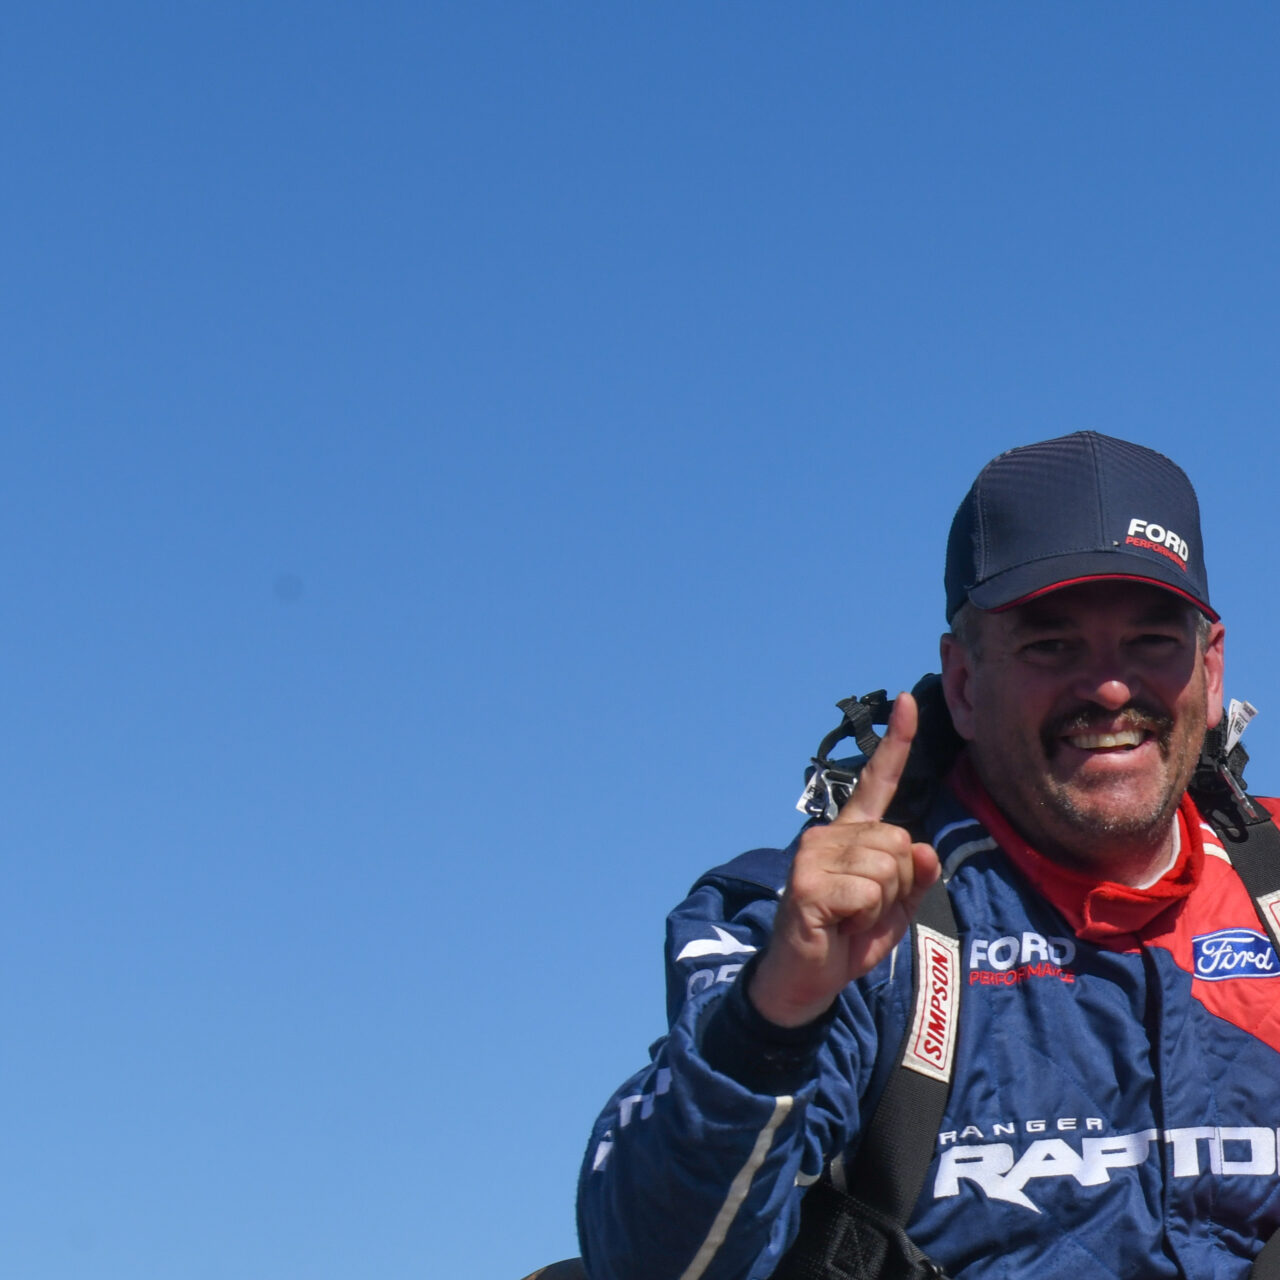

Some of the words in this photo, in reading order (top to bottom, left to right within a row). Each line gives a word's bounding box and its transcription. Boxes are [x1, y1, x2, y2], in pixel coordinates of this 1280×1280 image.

[1127, 518, 1189, 562] FORD
[969, 931, 1076, 971] FORD
[1197, 937, 1274, 972] Ford
[923, 947, 949, 1061] SIMPSON
[938, 1117, 1104, 1145] RANGER
